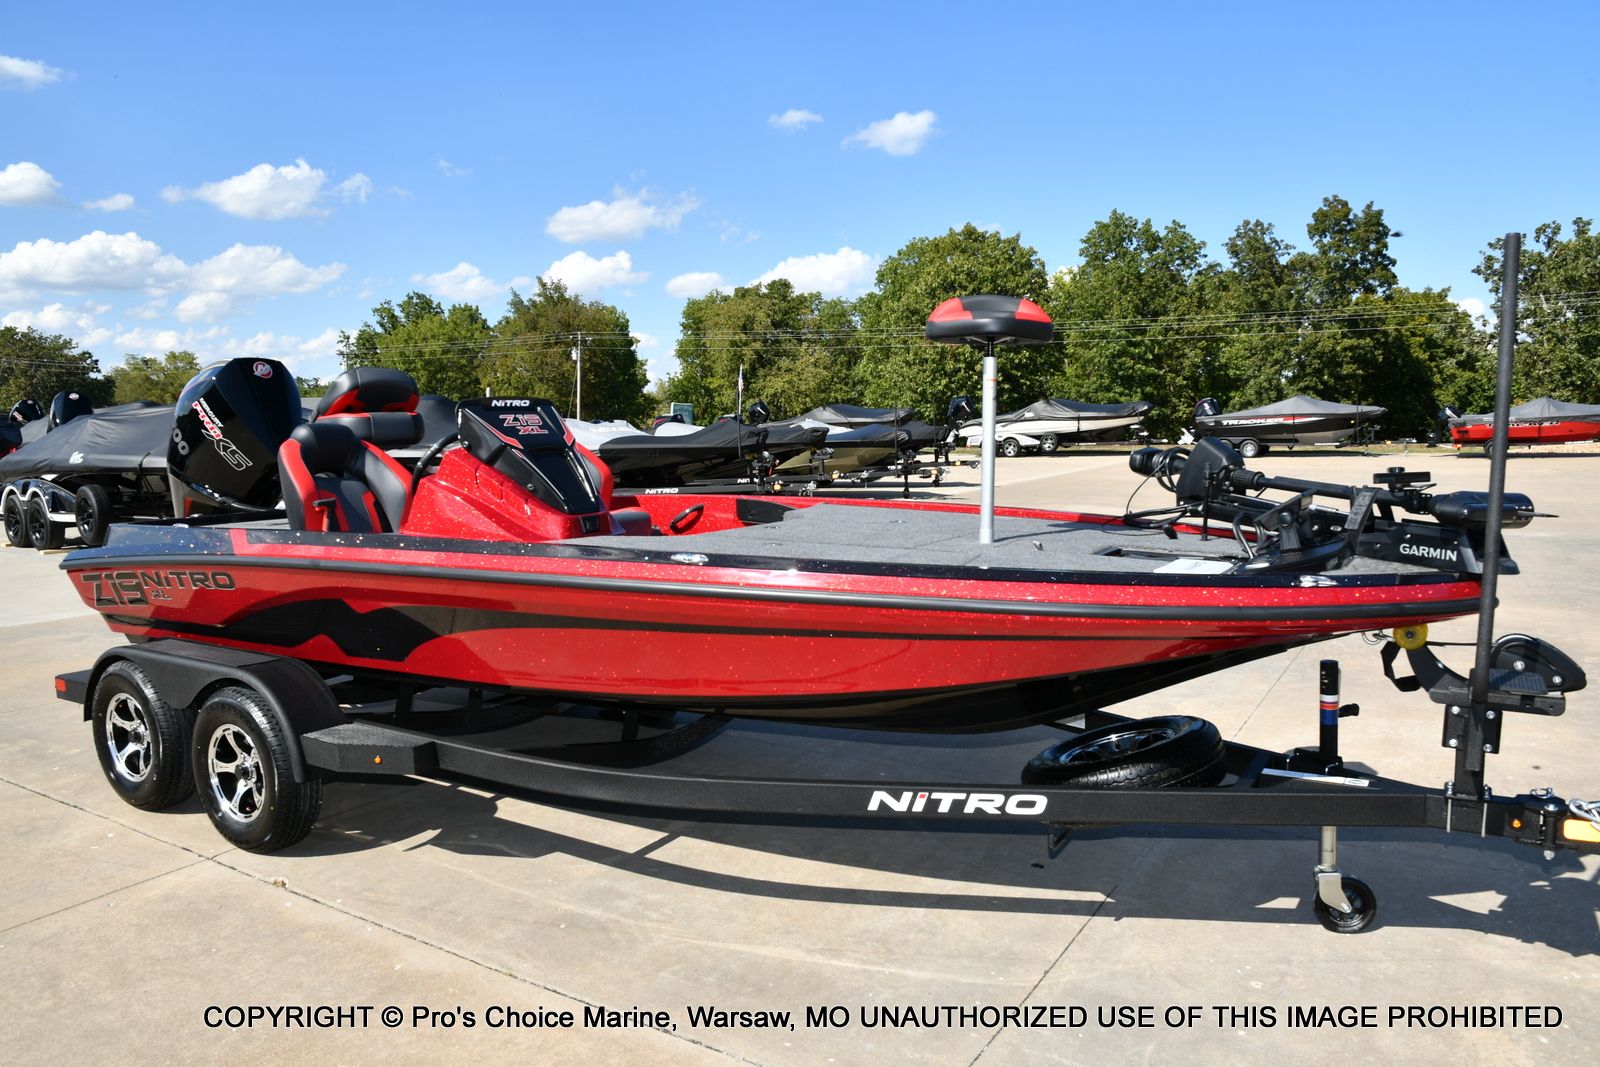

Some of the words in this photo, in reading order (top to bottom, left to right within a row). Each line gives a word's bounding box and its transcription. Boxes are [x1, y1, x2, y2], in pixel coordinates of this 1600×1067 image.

[491, 399, 530, 407] NITRO
[192, 401, 222, 440] PRO
[516, 425, 549, 435] XL
[645, 487, 679, 495] NITRO
[1399, 543, 1458, 562] GARMIN
[138, 570, 237, 590] NITRO
[867, 790, 1048, 816] NITRO
